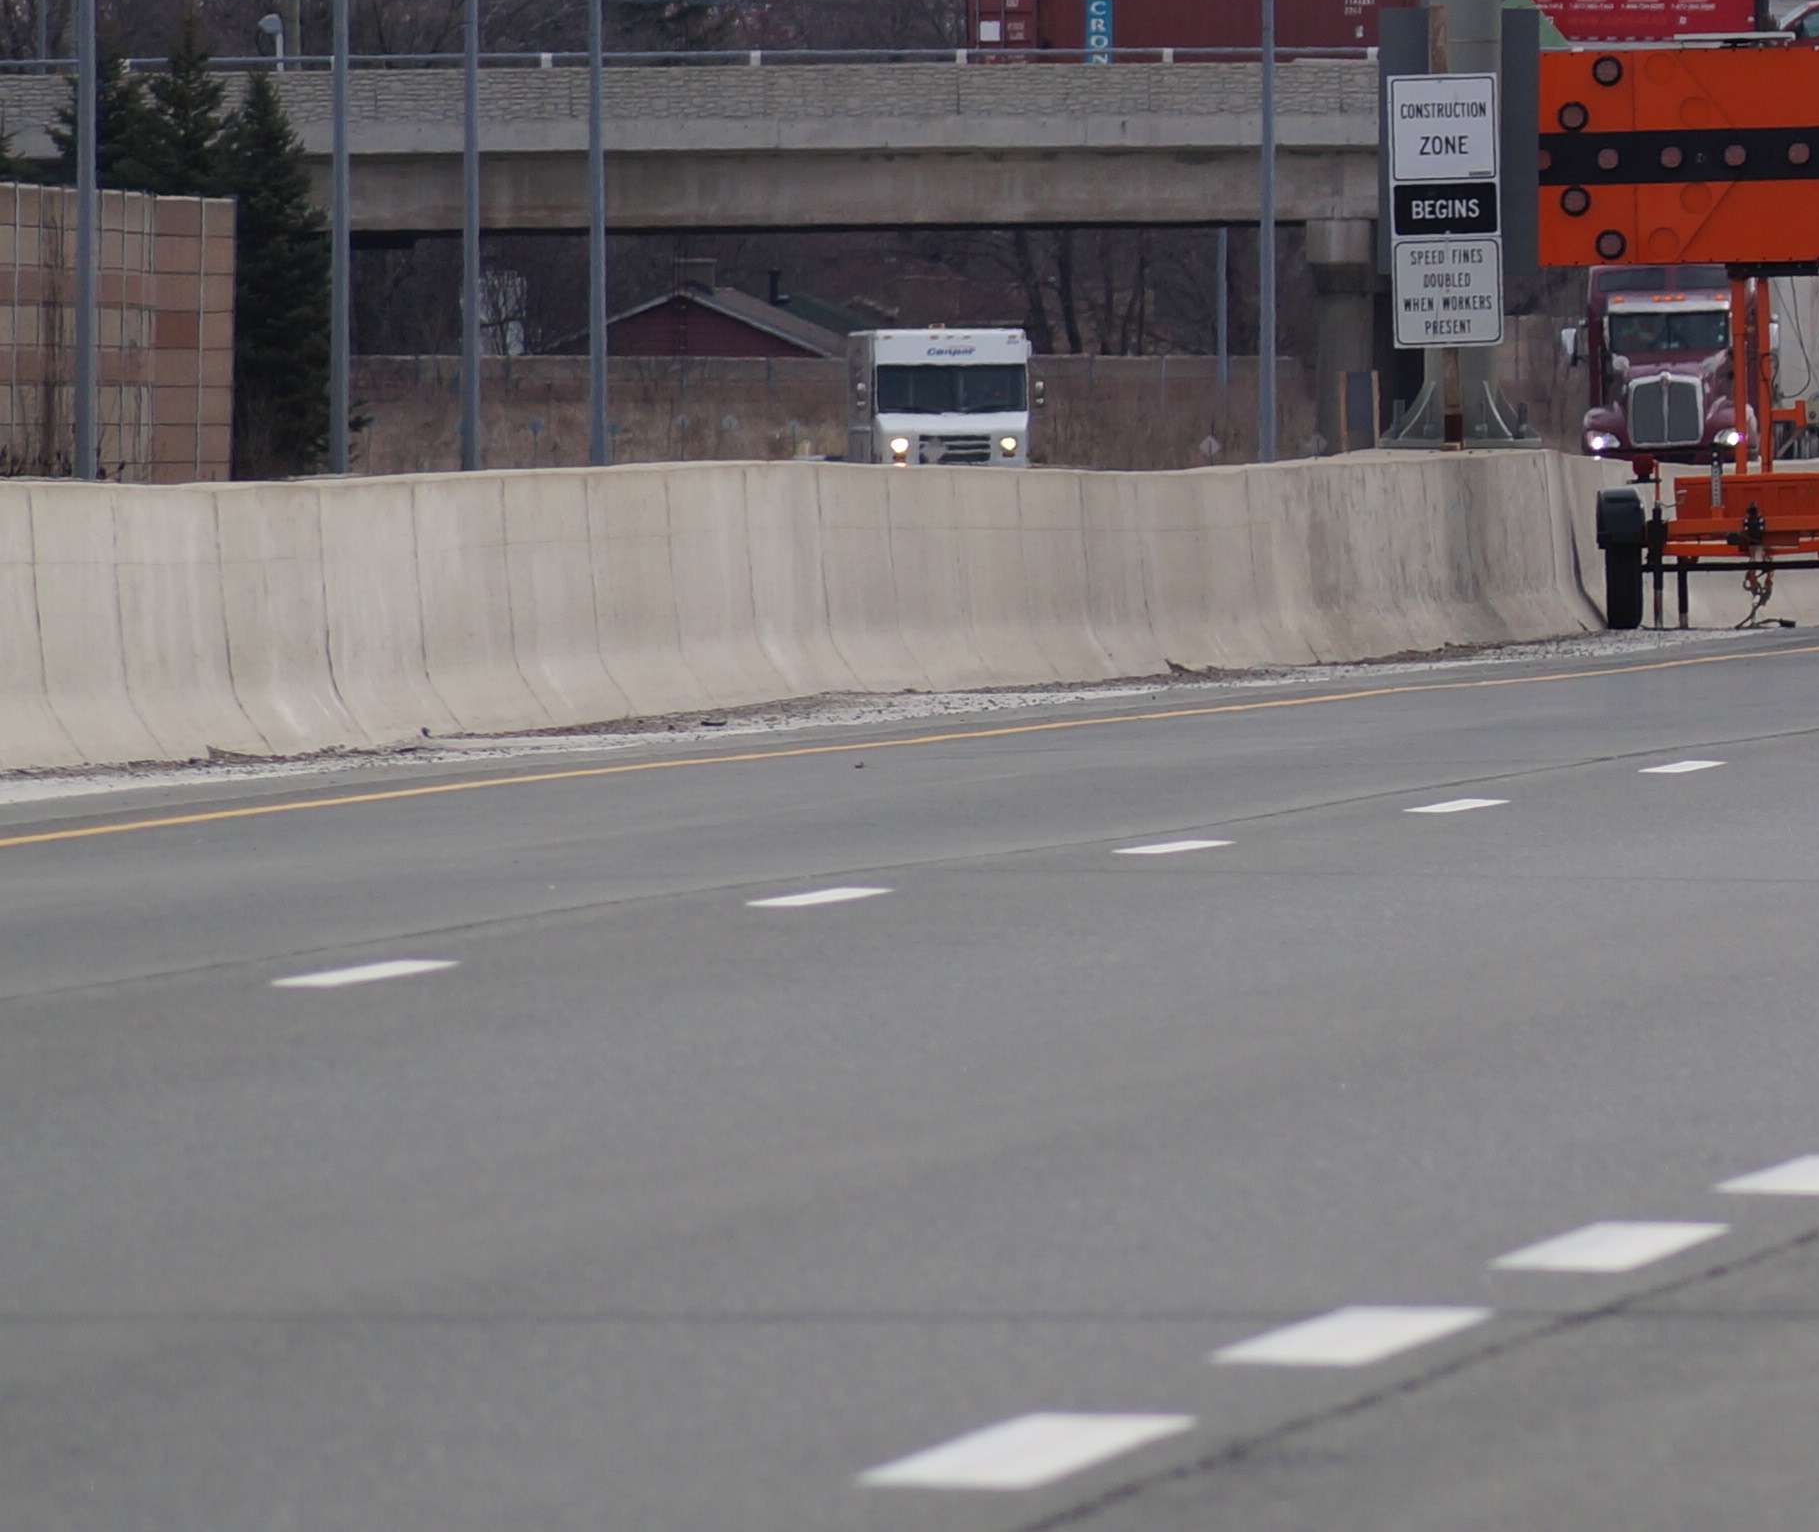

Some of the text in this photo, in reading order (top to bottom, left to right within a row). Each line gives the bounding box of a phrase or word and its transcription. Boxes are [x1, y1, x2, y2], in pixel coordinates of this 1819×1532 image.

[1400, 102, 1487, 120] CONSTRUCTION
[1418, 135, 1469, 156] ZONE
[1411, 198, 1481, 221] BEGINS
[1410, 248, 1484, 266] SPEED FINES
[1423, 272, 1472, 289] DOUBLED
[1403, 295, 1493, 312] WHEN WORKERS
[1425, 319, 1472, 336] PRESENT
